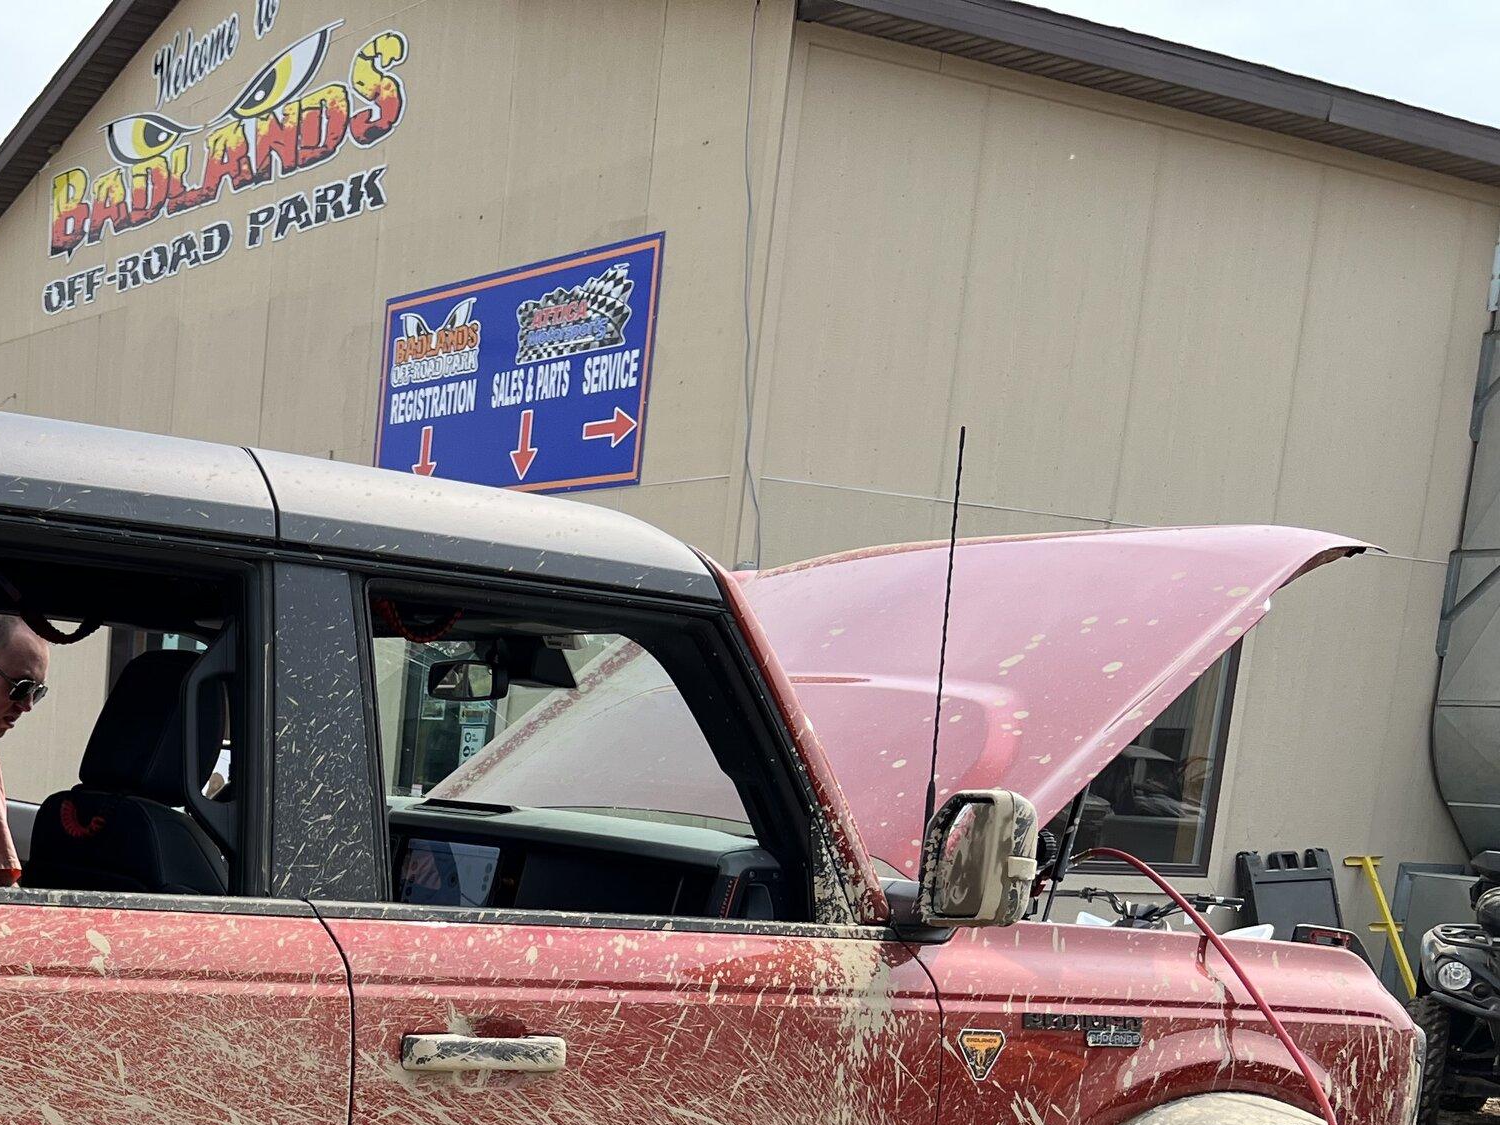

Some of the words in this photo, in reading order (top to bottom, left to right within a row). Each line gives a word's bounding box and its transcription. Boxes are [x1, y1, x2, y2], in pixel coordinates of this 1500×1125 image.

[153, 13, 239, 108] Welcome
[51, 30, 408, 262] BADLANDS
[42, 221, 233, 314] OFF-ROAD
[246, 165, 389, 249] PARK
[532, 299, 588, 328] ATTICA
[395, 322, 479, 364] BADLANDS
[392, 356, 443, 387] OFF-ROAD
[444, 348, 479, 377] PARK
[491, 369, 524, 408] SALES
[525, 366, 534, 403] &
[535, 360, 571, 401] PARTS
[582, 349, 640, 395] SERVICE
[389, 379, 478, 424] REGISTRATION
[1090, 1032, 1140, 1045] BADLANDS
